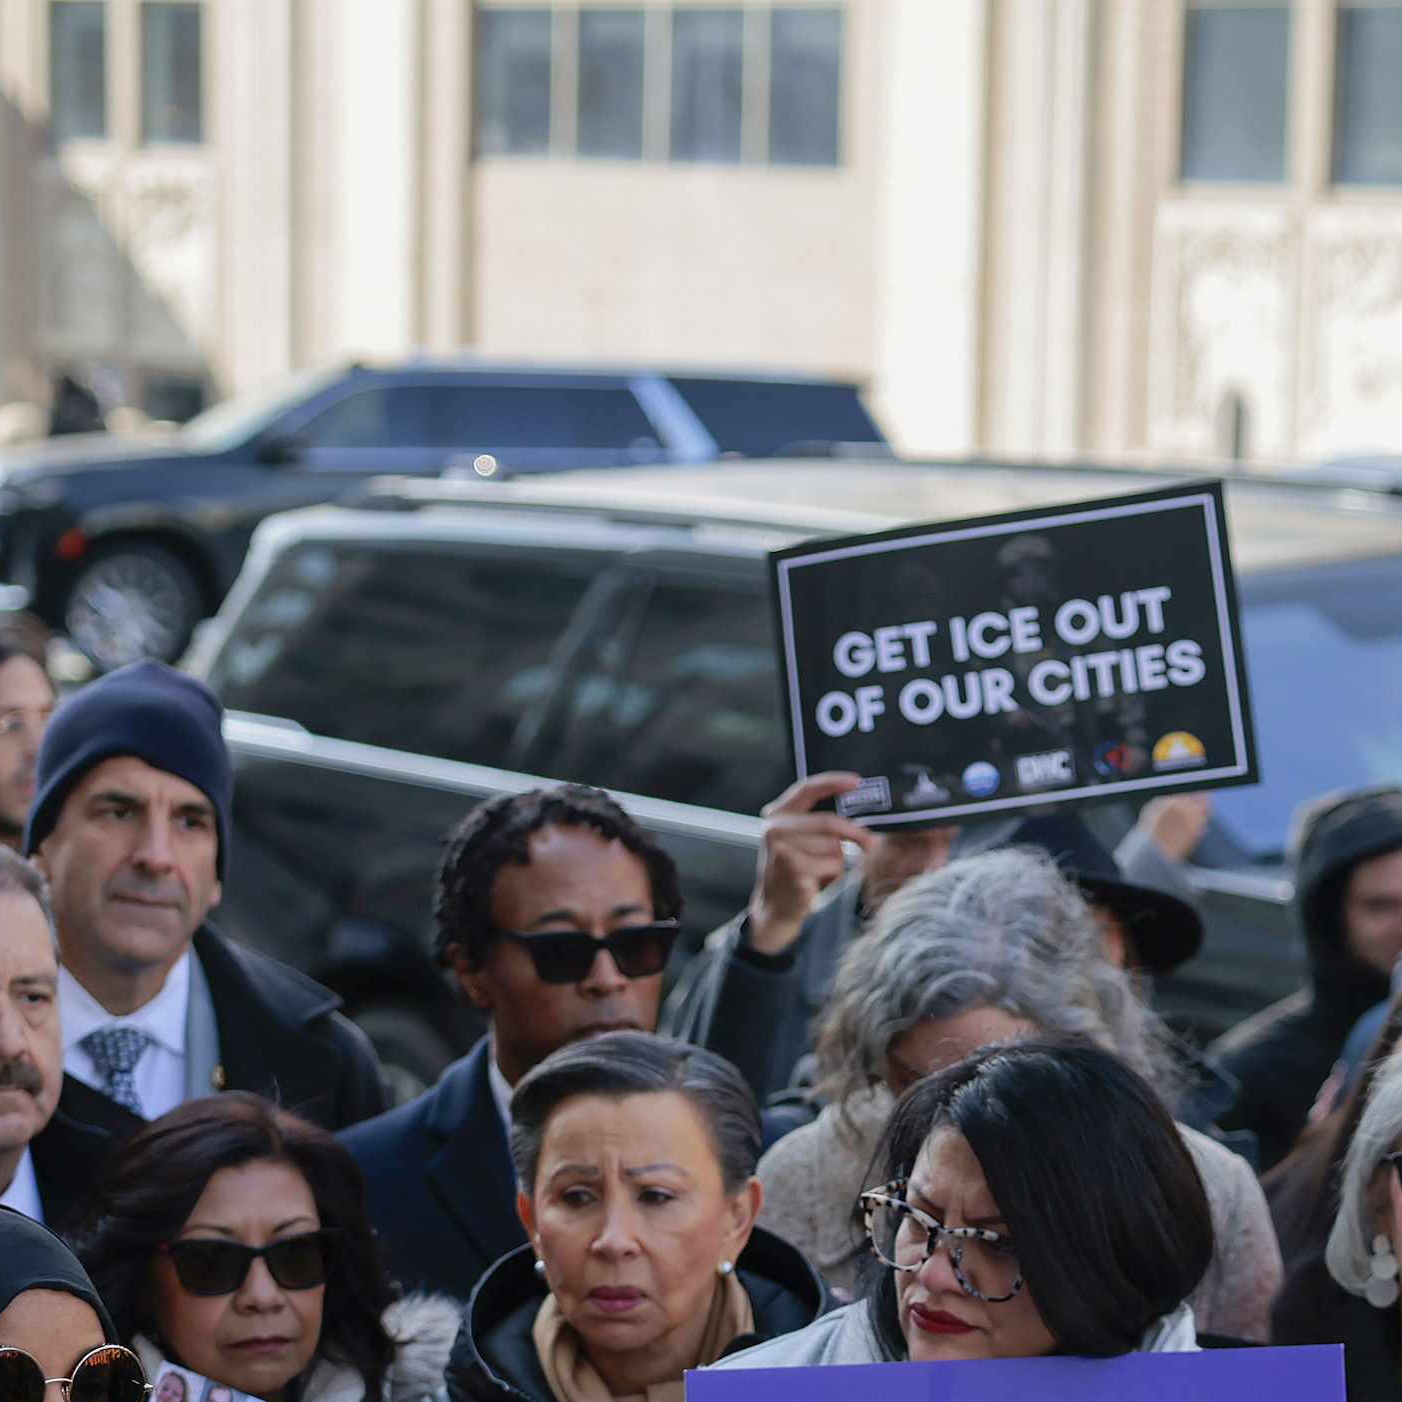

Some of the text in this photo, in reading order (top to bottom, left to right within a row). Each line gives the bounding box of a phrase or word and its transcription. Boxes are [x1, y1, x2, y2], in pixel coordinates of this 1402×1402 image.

[833, 585, 1172, 679] GET ICE OUT
[815, 638, 1207, 738] OF OUR CITIES
